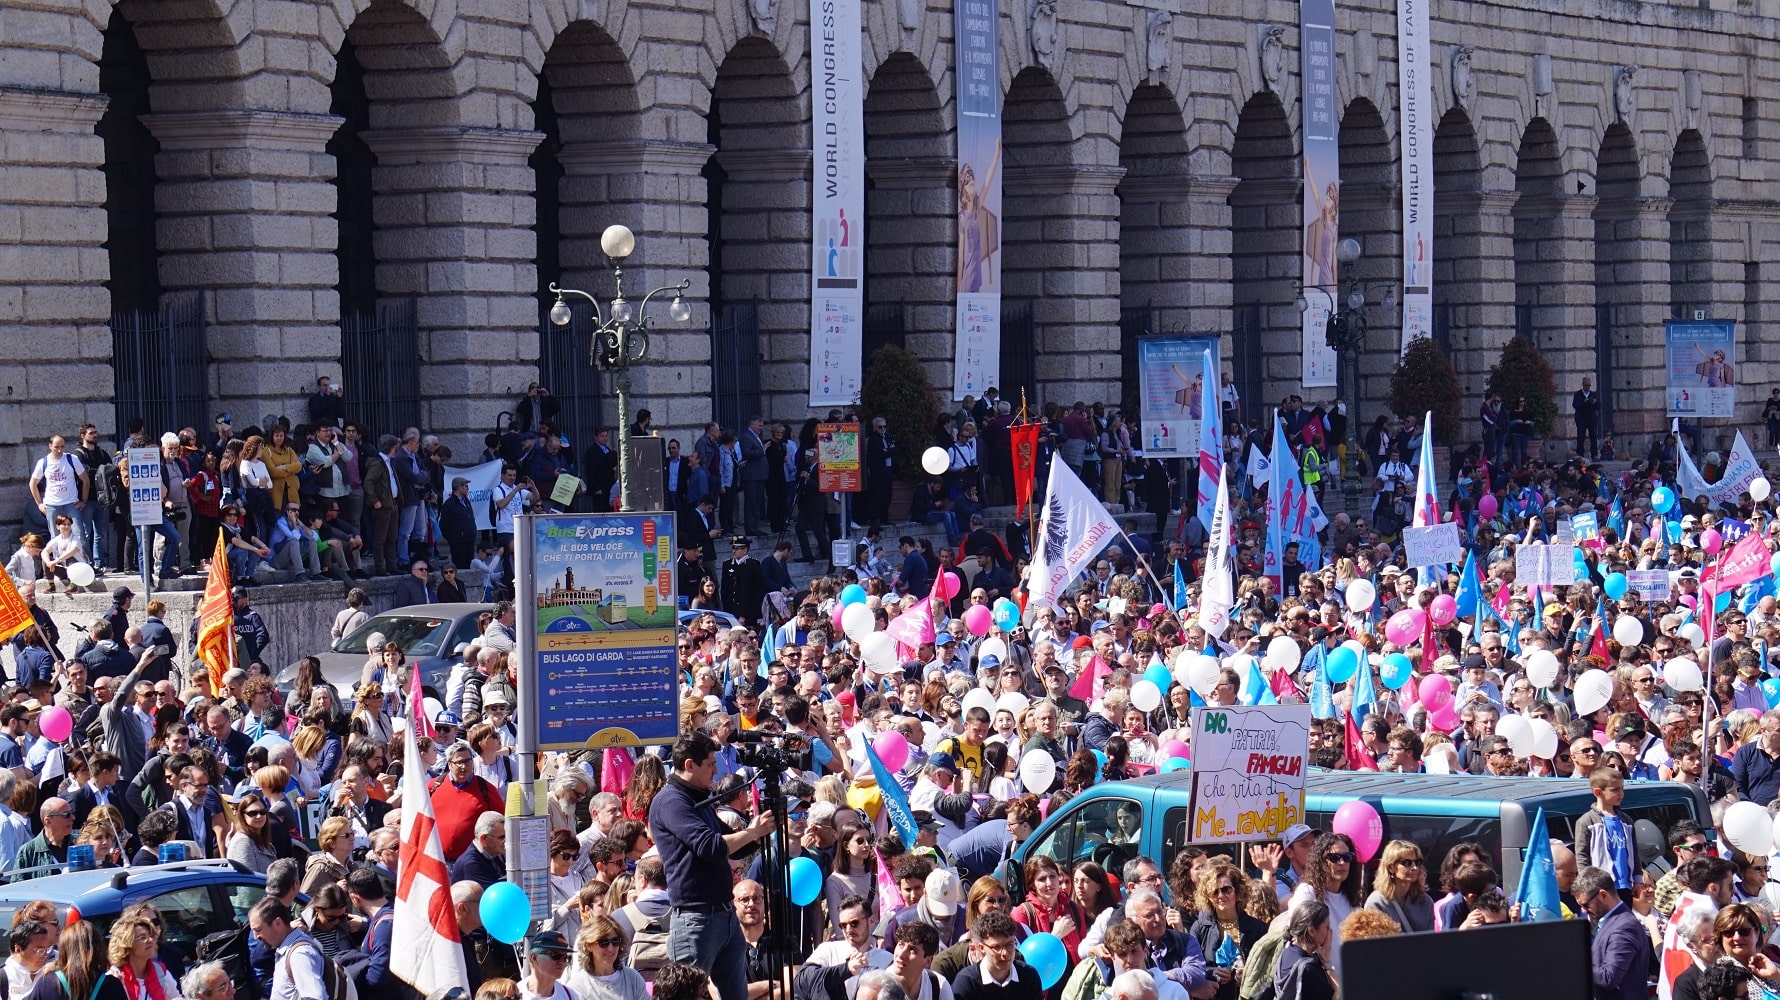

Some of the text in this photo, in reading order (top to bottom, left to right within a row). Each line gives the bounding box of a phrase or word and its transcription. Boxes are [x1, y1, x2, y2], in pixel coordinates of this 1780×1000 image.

[1406, 46, 1414, 63] OF
[823, 1, 838, 199] WORLD CONGRESS
[1407, 69, 1417, 158] CONGRESS
[1410, 162, 1419, 224] WORLD
[1712, 482, 1746, 504] NOSTRI
[560, 542, 623, 552] IL BUS VELOCE
[1412, 536, 1458, 552] FAMIGLIA
[543, 550, 638, 562] CHE TI PORTA IN CITTÀ
[544, 652, 624, 664] BUS LAGO DI GARDA
[1246, 753, 1302, 777] FAMIGLIA
[1204, 774, 1278, 798] che vita di
